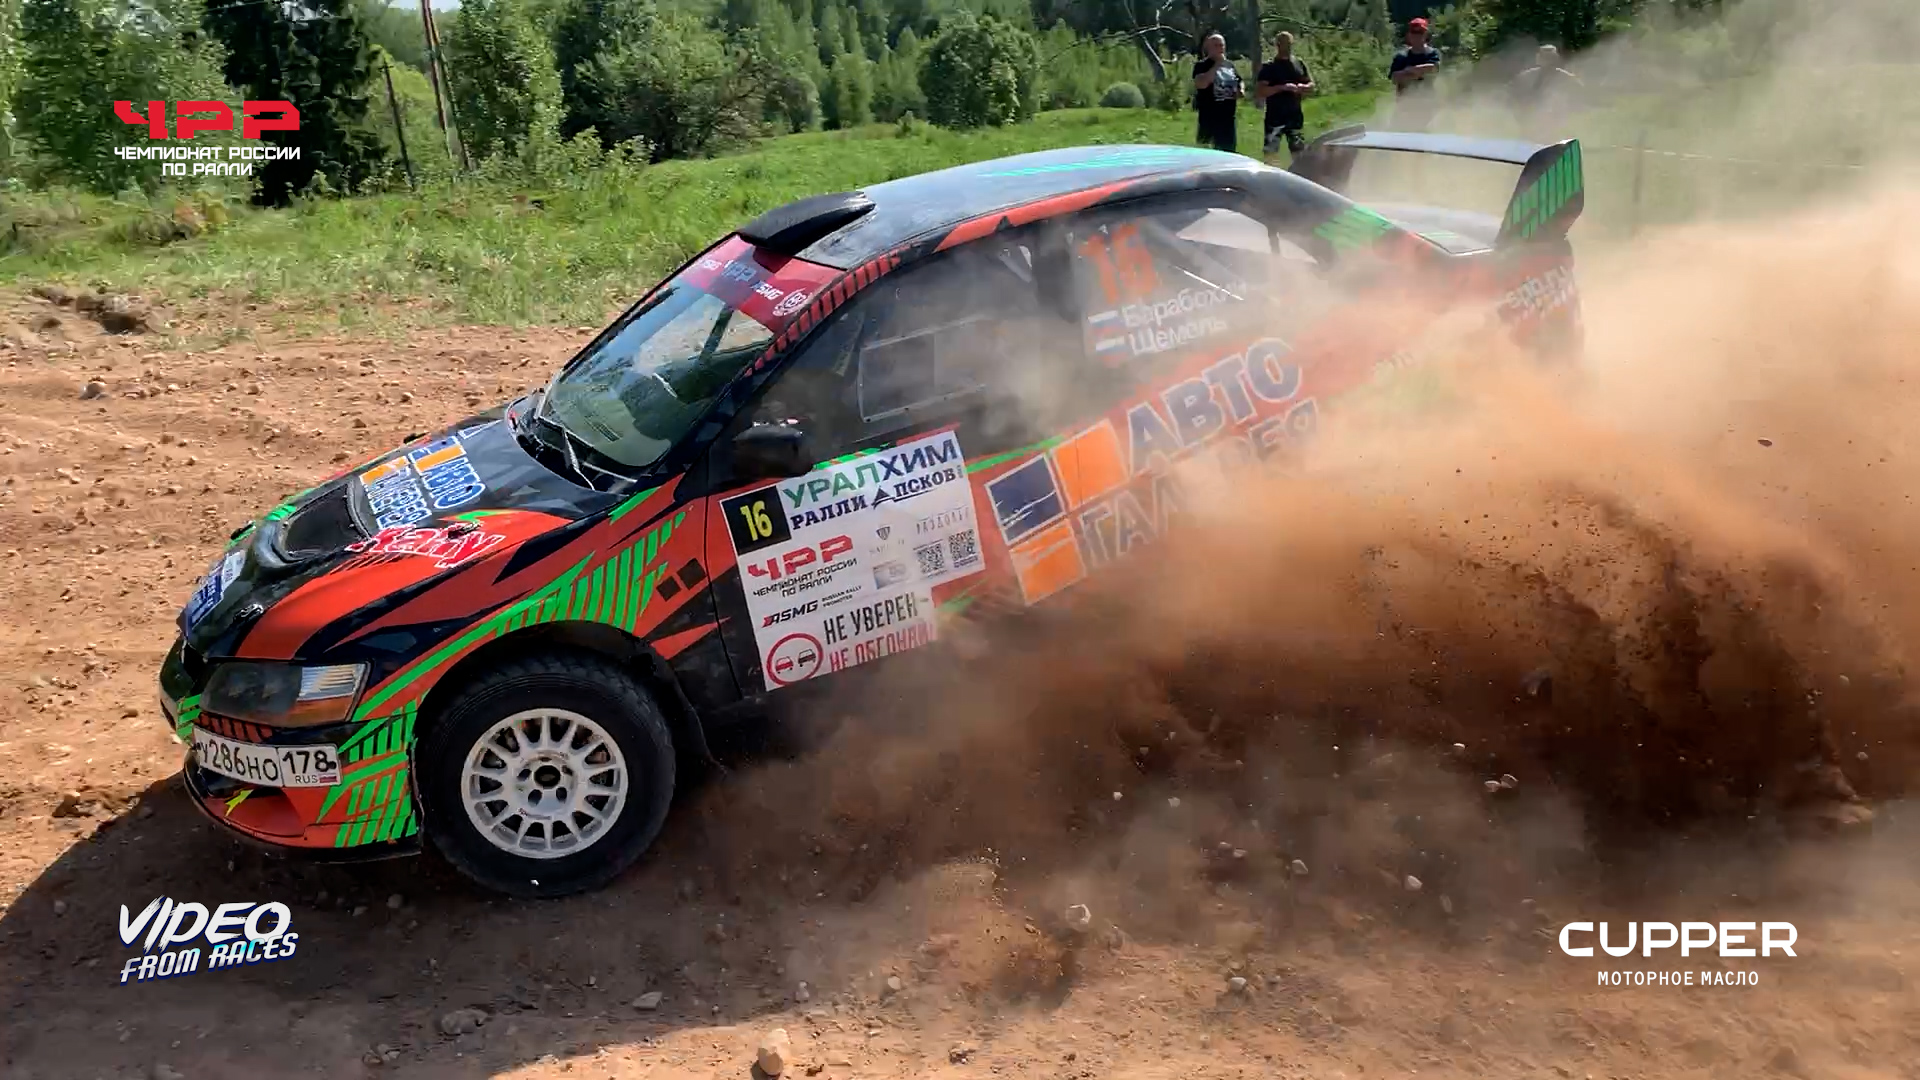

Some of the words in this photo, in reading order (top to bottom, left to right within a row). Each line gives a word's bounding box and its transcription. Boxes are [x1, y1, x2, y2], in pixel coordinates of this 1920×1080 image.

[1078, 219, 1157, 304] 16
[1127, 337, 1302, 482] АВТО
[782, 438, 959, 508] УРАЛХИМ
[1078, 397, 1320, 570] ГАЛРЕЯ
[739, 500, 773, 542] 16
[790, 494, 869, 530] РАЛЛИ
[894, 467, 957, 498] ПСКОВ
[747, 534, 854, 581] ЧРР
[753, 571, 814, 597] ЧЕМПИОНАТ
[817, 558, 858, 576] РОССИИ
[782, 586, 796, 598] ПО
[800, 575, 833, 592] РАЛЛИ
[823, 615, 848, 645] НЕ
[850, 591, 918, 637] УВЕРЕН
[829, 648, 849, 672] НЕ
[282, 750, 329, 773] 178
[295, 775, 319, 784] RUS
